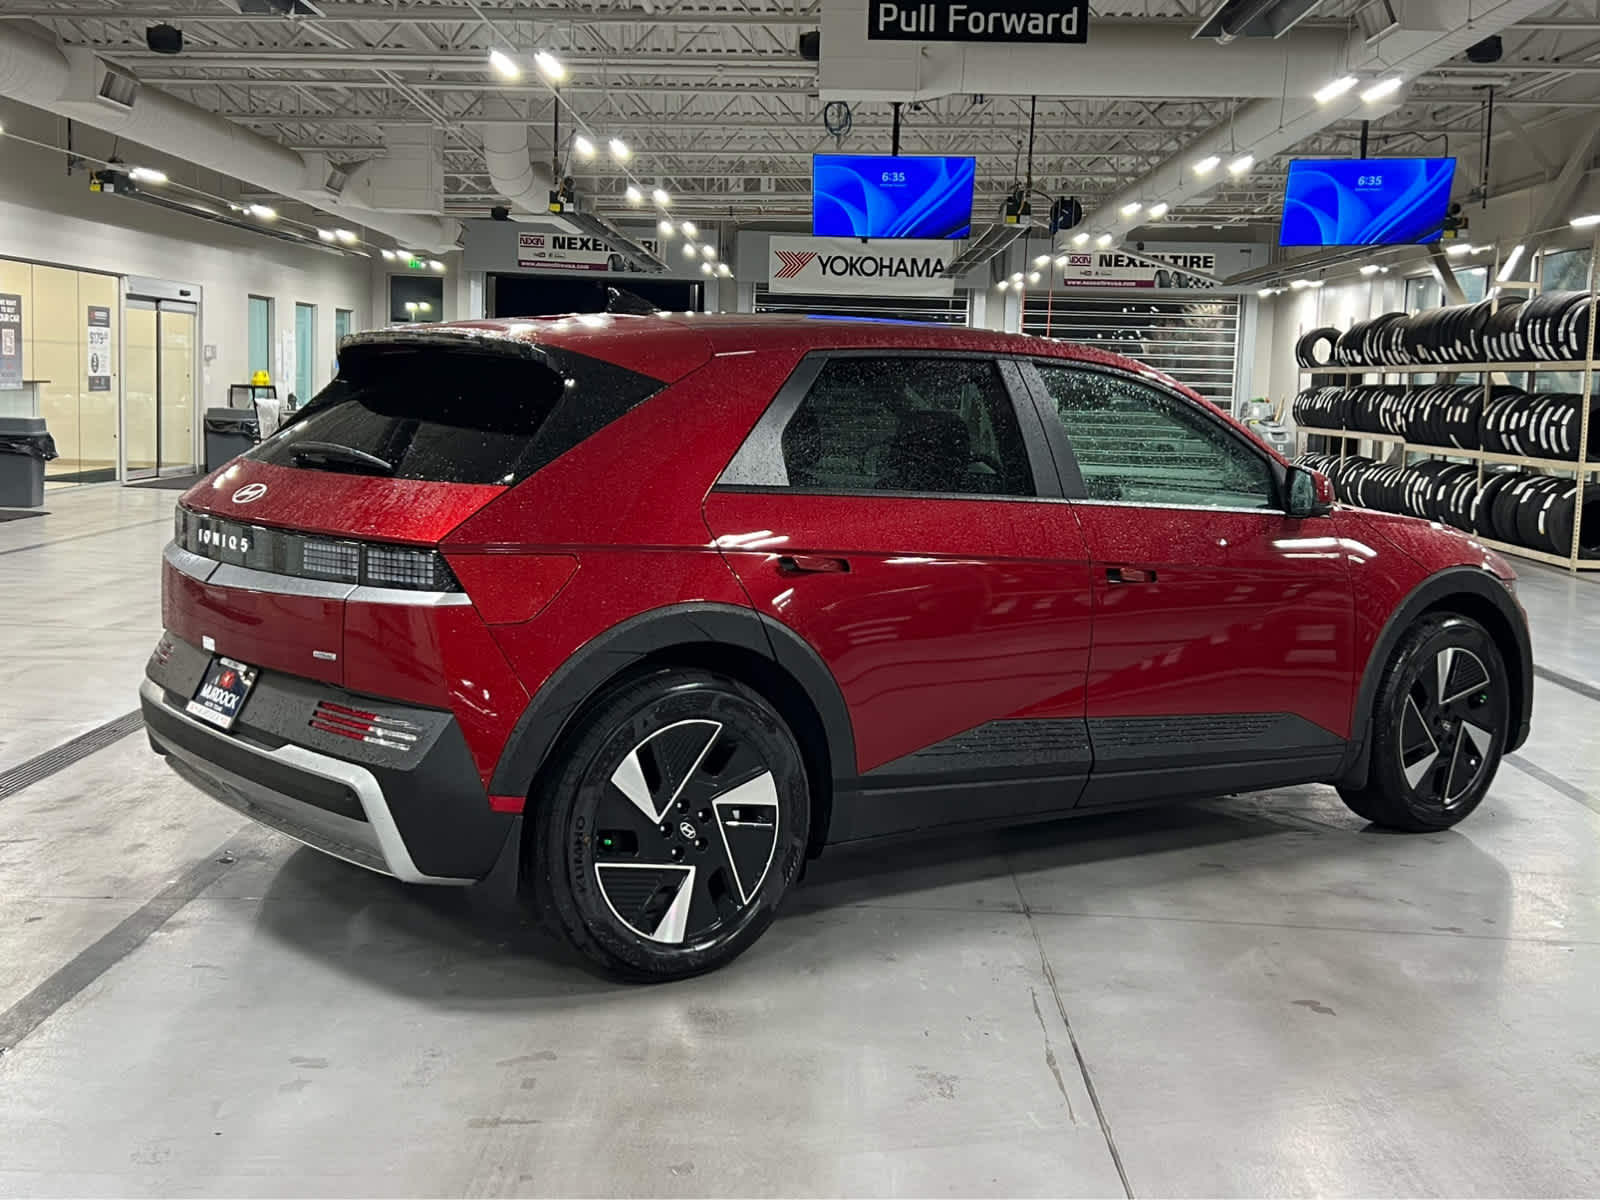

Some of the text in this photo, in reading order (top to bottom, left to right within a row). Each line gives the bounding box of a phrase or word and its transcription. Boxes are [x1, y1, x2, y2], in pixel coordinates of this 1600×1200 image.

[878, 3, 1079, 35] Pull Forward
[881, 171, 906, 182] 6:35
[1357, 175, 1383, 186] 6:35
[817, 255, 946, 278] YOKOHAMA
[1169, 255, 1214, 269] TIRE
[198, 528, 249, 552] IONIQ 5
[200, 682, 240, 710] MURDOCK
